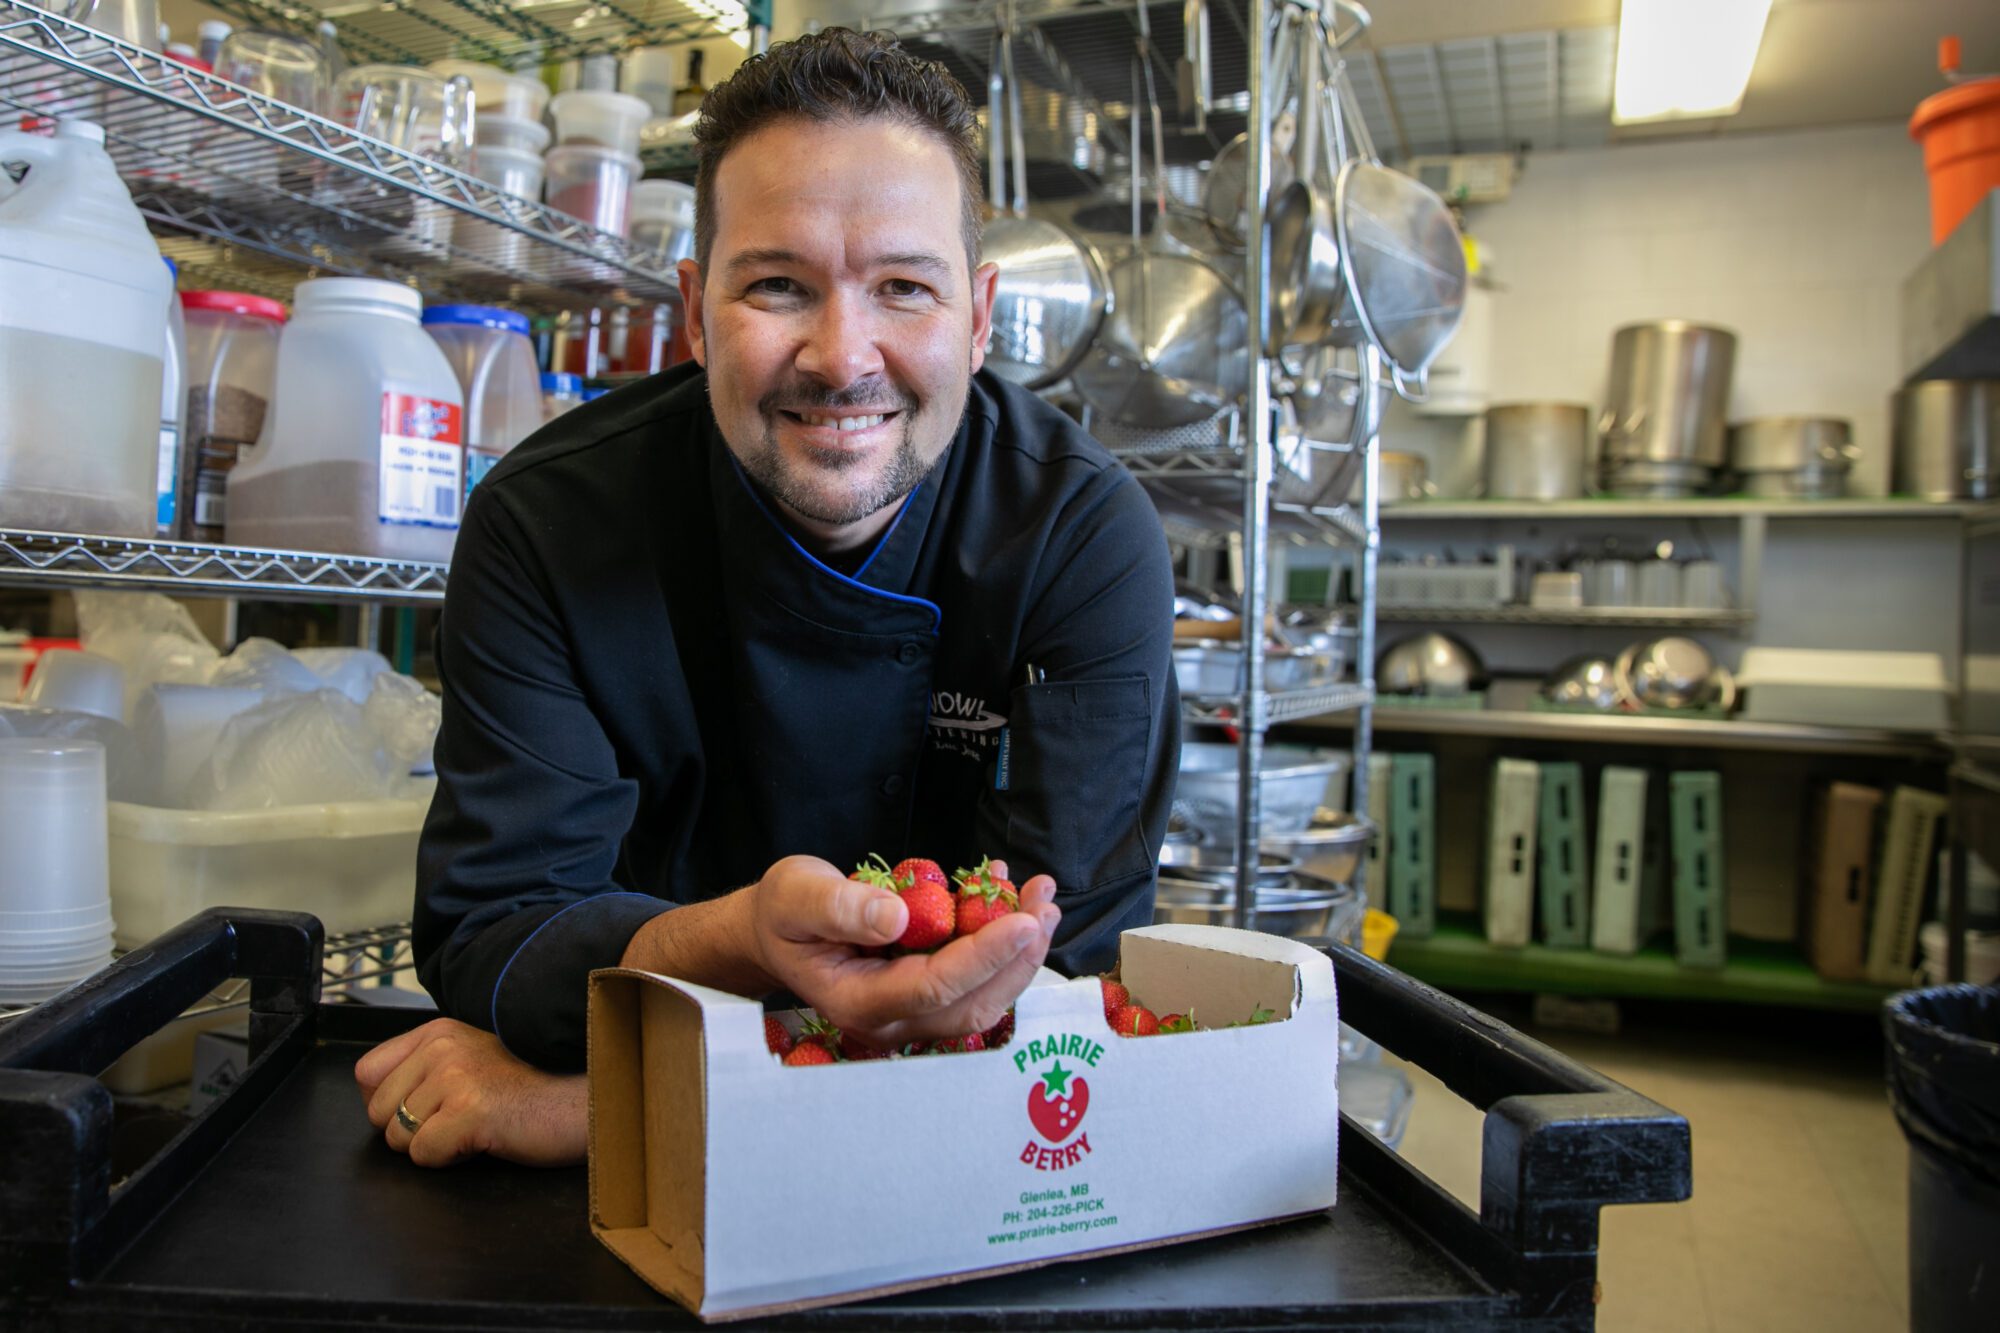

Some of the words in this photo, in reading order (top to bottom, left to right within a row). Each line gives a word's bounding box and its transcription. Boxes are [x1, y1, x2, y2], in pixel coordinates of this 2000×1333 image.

[1013, 1033, 1105, 1074] PRAIRIE
[1019, 1131, 1092, 1172] BERRY
[1020, 1189, 1067, 1205] Glenlea,
[1070, 1183, 1089, 1198] MB
[1003, 1210, 1023, 1225] PH:
[1027, 1197, 1105, 1221] 204-226-PICK
[987, 1214, 1118, 1245] www.prairie-berry.com
